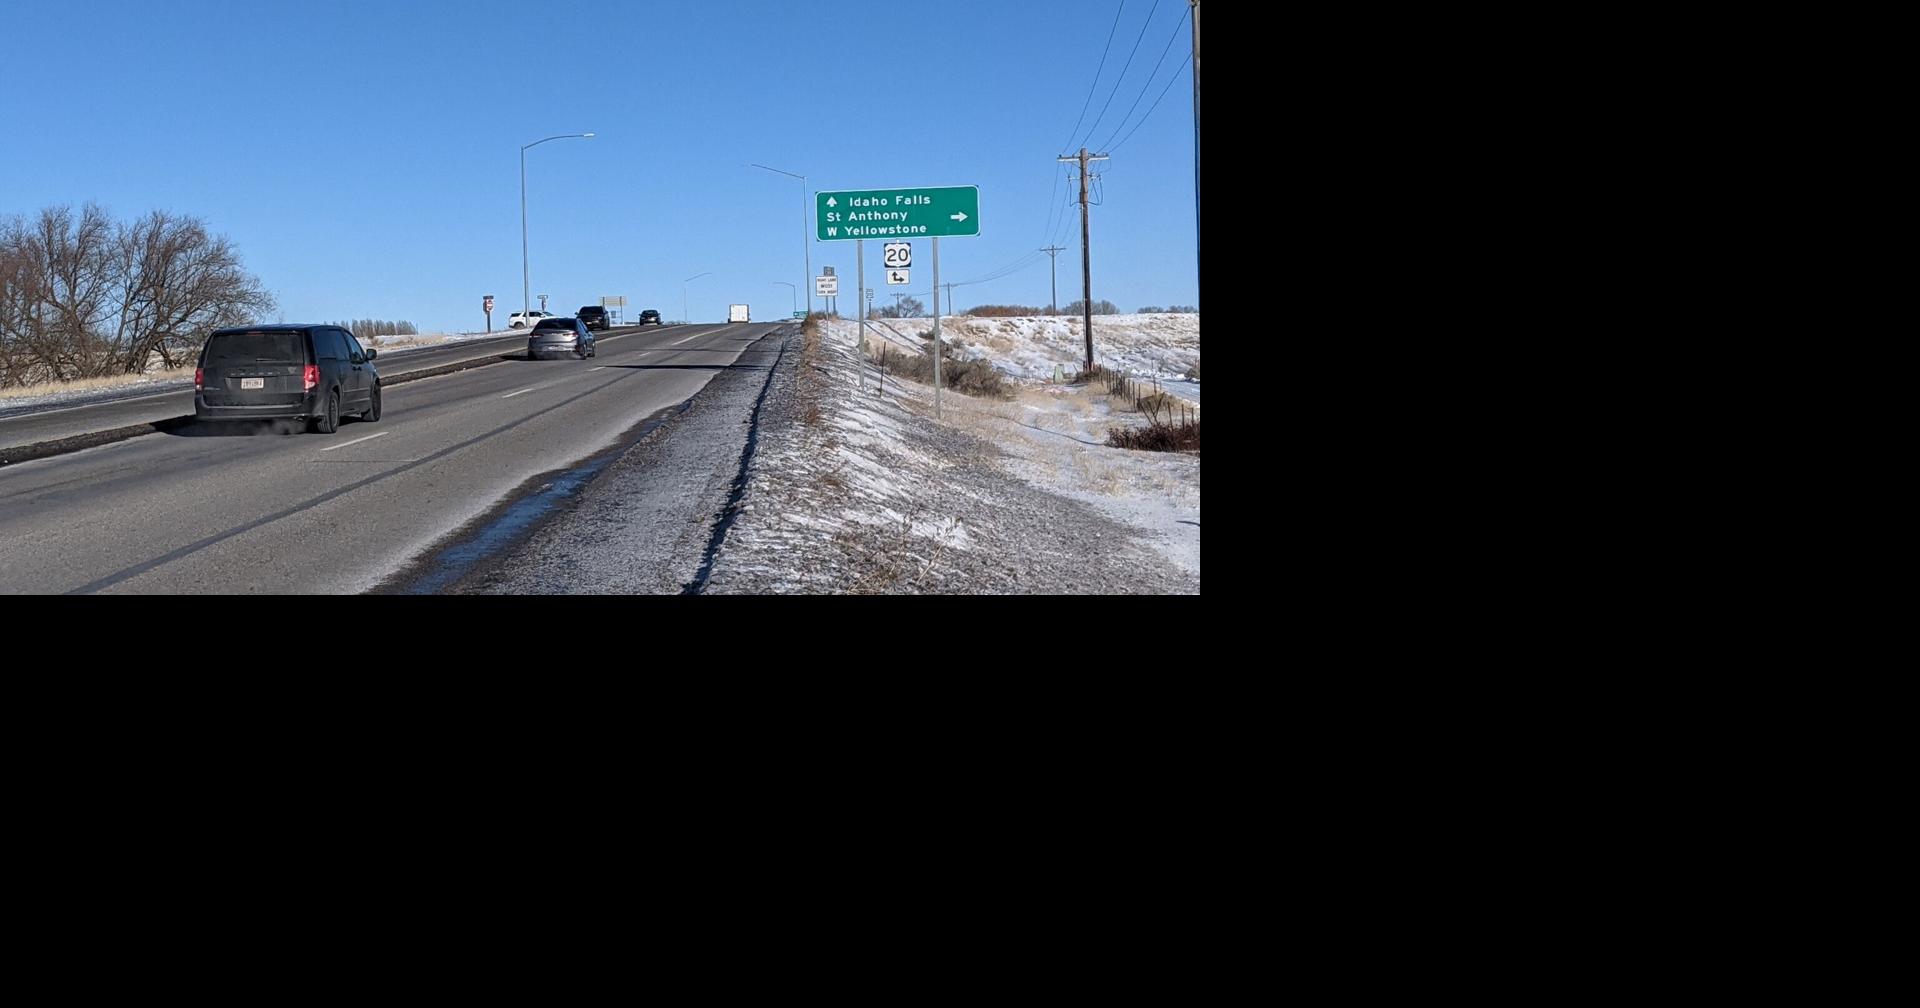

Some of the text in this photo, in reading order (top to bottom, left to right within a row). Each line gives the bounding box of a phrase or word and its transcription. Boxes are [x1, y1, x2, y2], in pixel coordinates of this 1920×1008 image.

[849, 195, 931, 207] Idaho Falls
[827, 211, 908, 222] St Anthony
[827, 224, 927, 237] W Yellowstone
[886, 248, 909, 262] 20
